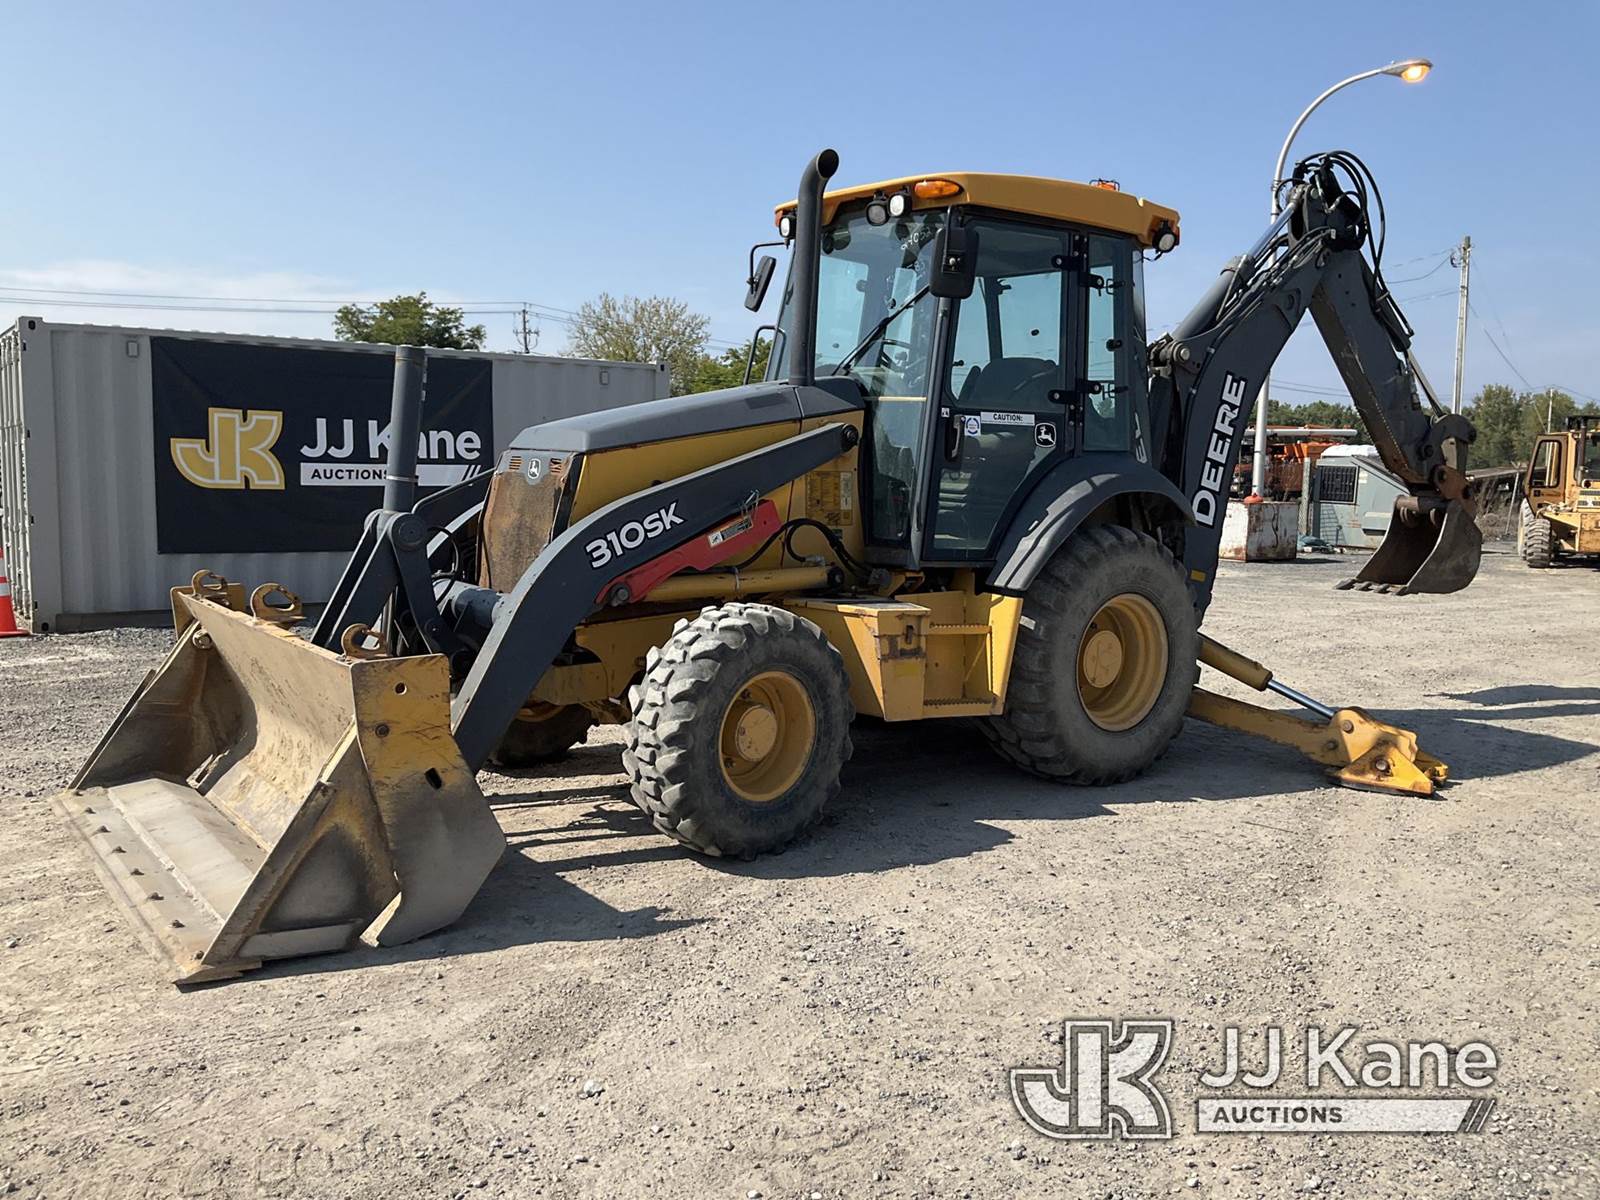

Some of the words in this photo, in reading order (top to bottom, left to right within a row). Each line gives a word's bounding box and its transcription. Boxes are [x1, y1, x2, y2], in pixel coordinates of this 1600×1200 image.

[170, 407, 285, 490] JK
[300, 418, 353, 459] JJ
[368, 420, 481, 460] Kne
[1192, 374, 1246, 525] DEERE
[585, 503, 683, 568] 310SK
